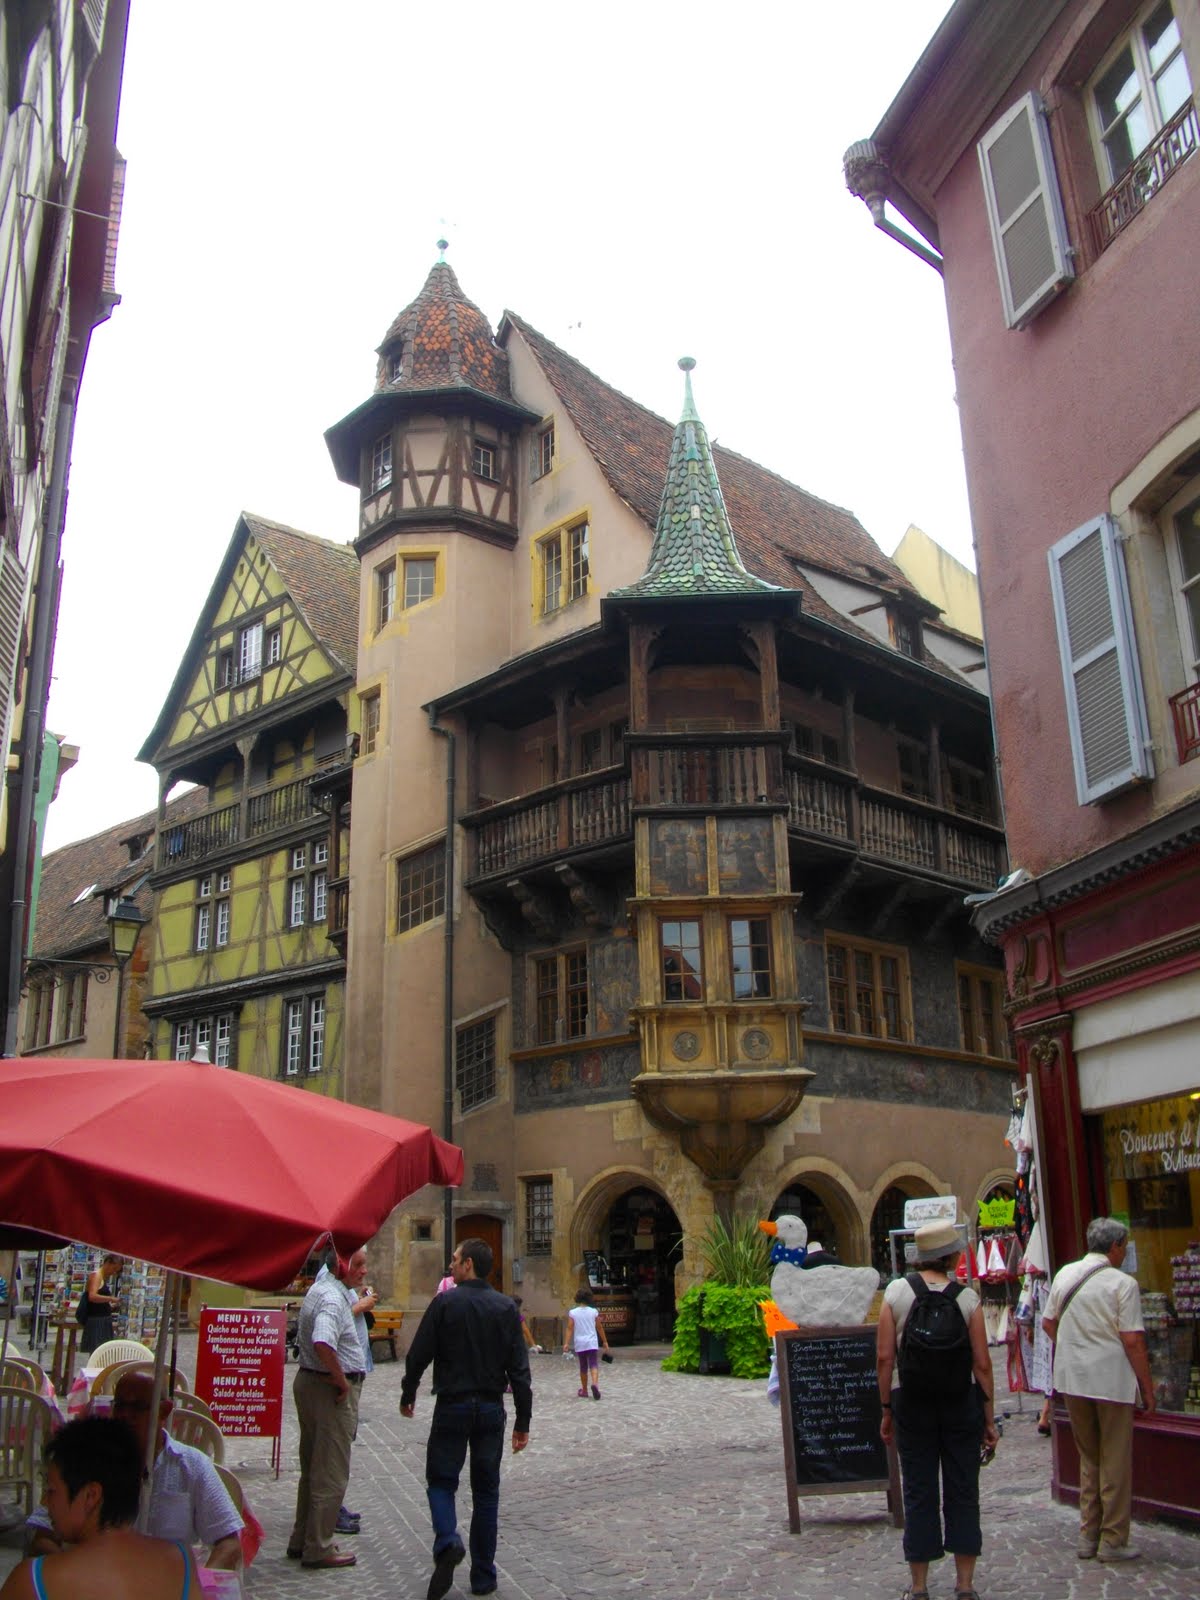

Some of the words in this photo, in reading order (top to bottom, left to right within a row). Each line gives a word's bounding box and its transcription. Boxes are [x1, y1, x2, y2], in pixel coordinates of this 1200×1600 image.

[1120, 1129, 1175, 1155] Douceurs
[1180, 1121, 1192, 1147] &
[217, 1313, 241, 1323] MENU
[243, 1315, 248, 1323] à
[251, 1315, 261, 1323] 17
[263, 1315, 270, 1324] €
[207, 1323, 229, 1334] Quiche
[240, 1324, 257, 1334] Tarte
[258, 1327, 279, 1336] oignon
[206, 1334, 245, 1344] Jambonneau
[211, 1344, 235, 1354] Mousse
[236, 1346, 262, 1354] chocolat
[221, 1354, 238, 1364] Tarte
[239, 1357, 262, 1365] maison
[212, 1376, 237, 1386] MENU
[239, 1377, 244, 1386] à
[247, 1377, 257, 1386] 18
[259, 1378, 266, 1386] €
[213, 1388, 235, 1398] Salade
[236, 1389, 264, 1398] orbelaise
[209, 1401, 245, 1411] Choucroute
[246, 1404, 266, 1413] garnie
[218, 1412, 246, 1424] Fromage
[220, 1423, 233, 1433] rbet
[243, 1423, 261, 1433] Tarte
